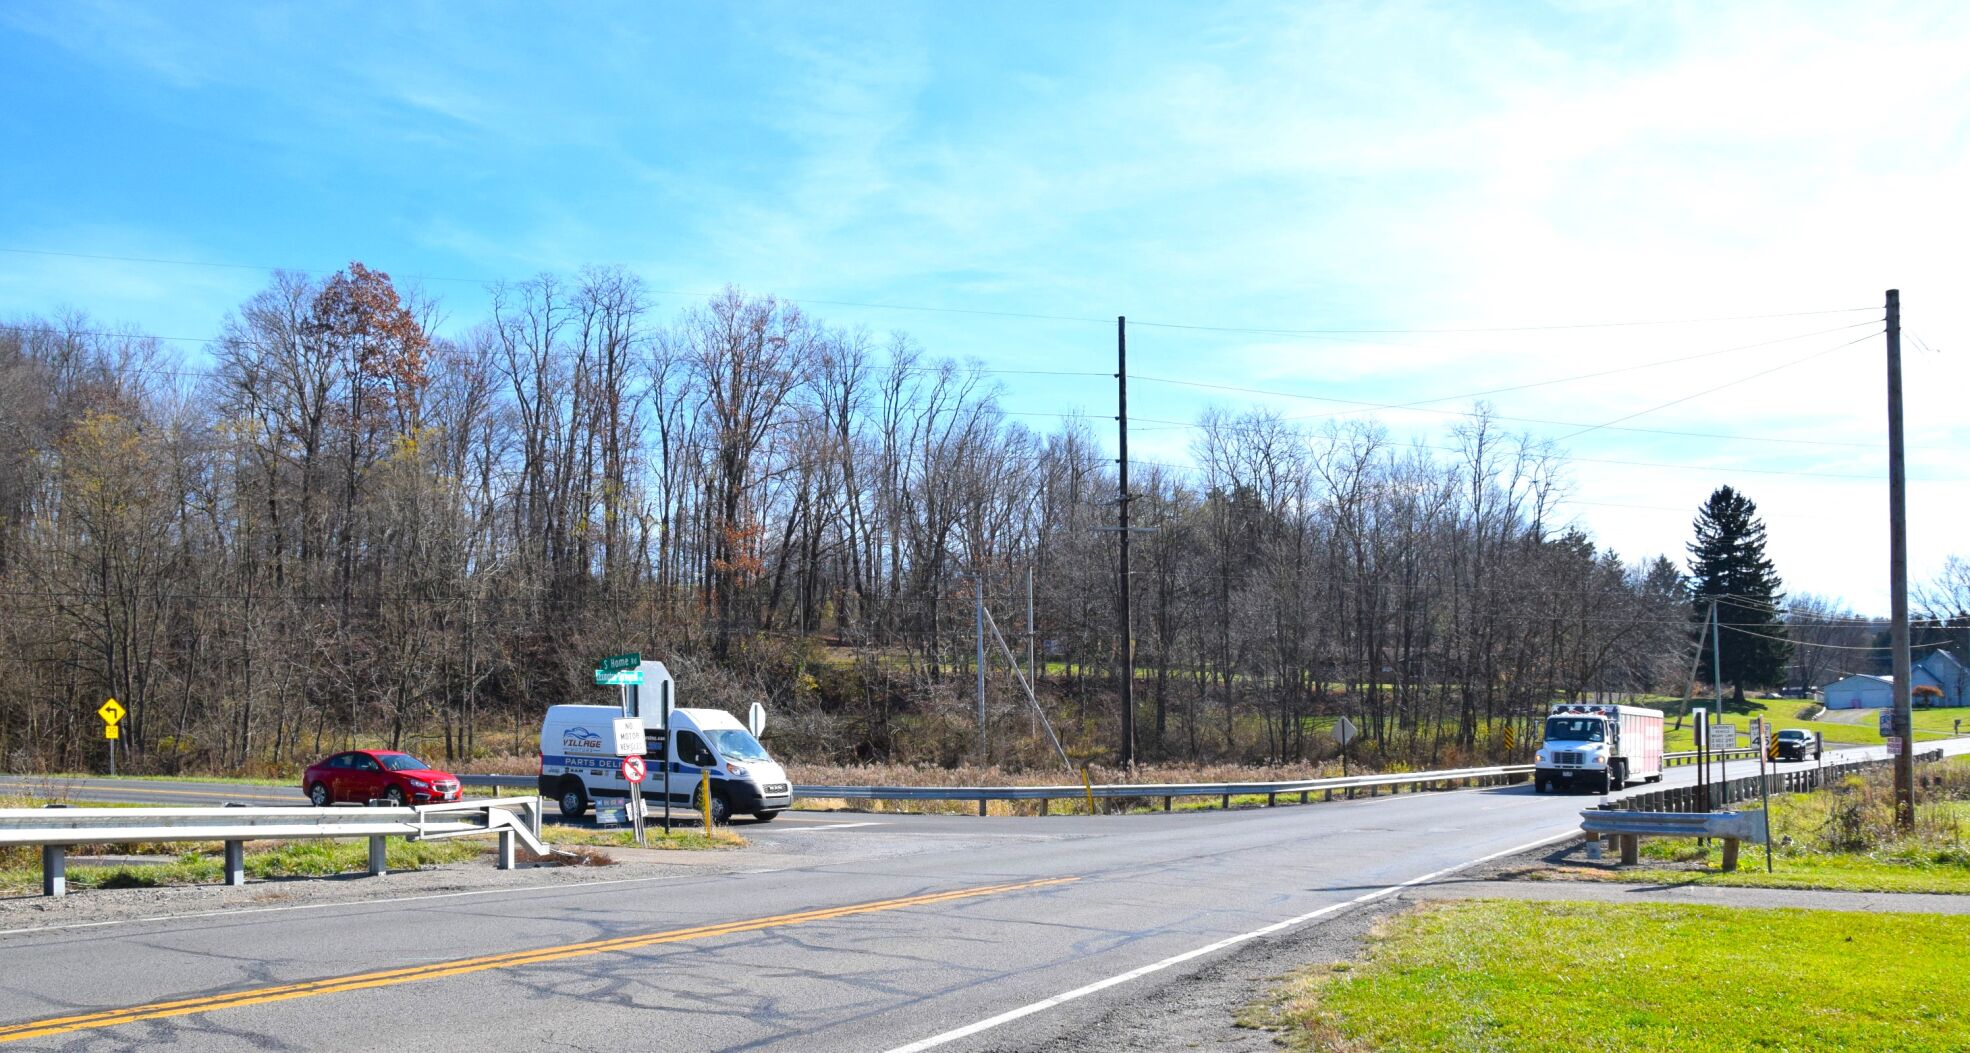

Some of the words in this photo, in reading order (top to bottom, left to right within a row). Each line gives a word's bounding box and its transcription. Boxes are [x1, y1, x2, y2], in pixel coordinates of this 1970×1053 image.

[603, 659, 608, 670] S
[610, 657, 629, 669] Home
[624, 722, 634, 730] NO
[620, 731, 640, 741] MOTOR
[563, 739, 602, 748] VILLAGE
[565, 758, 595, 767] PARTS
[599, 760, 622, 768] DELI
